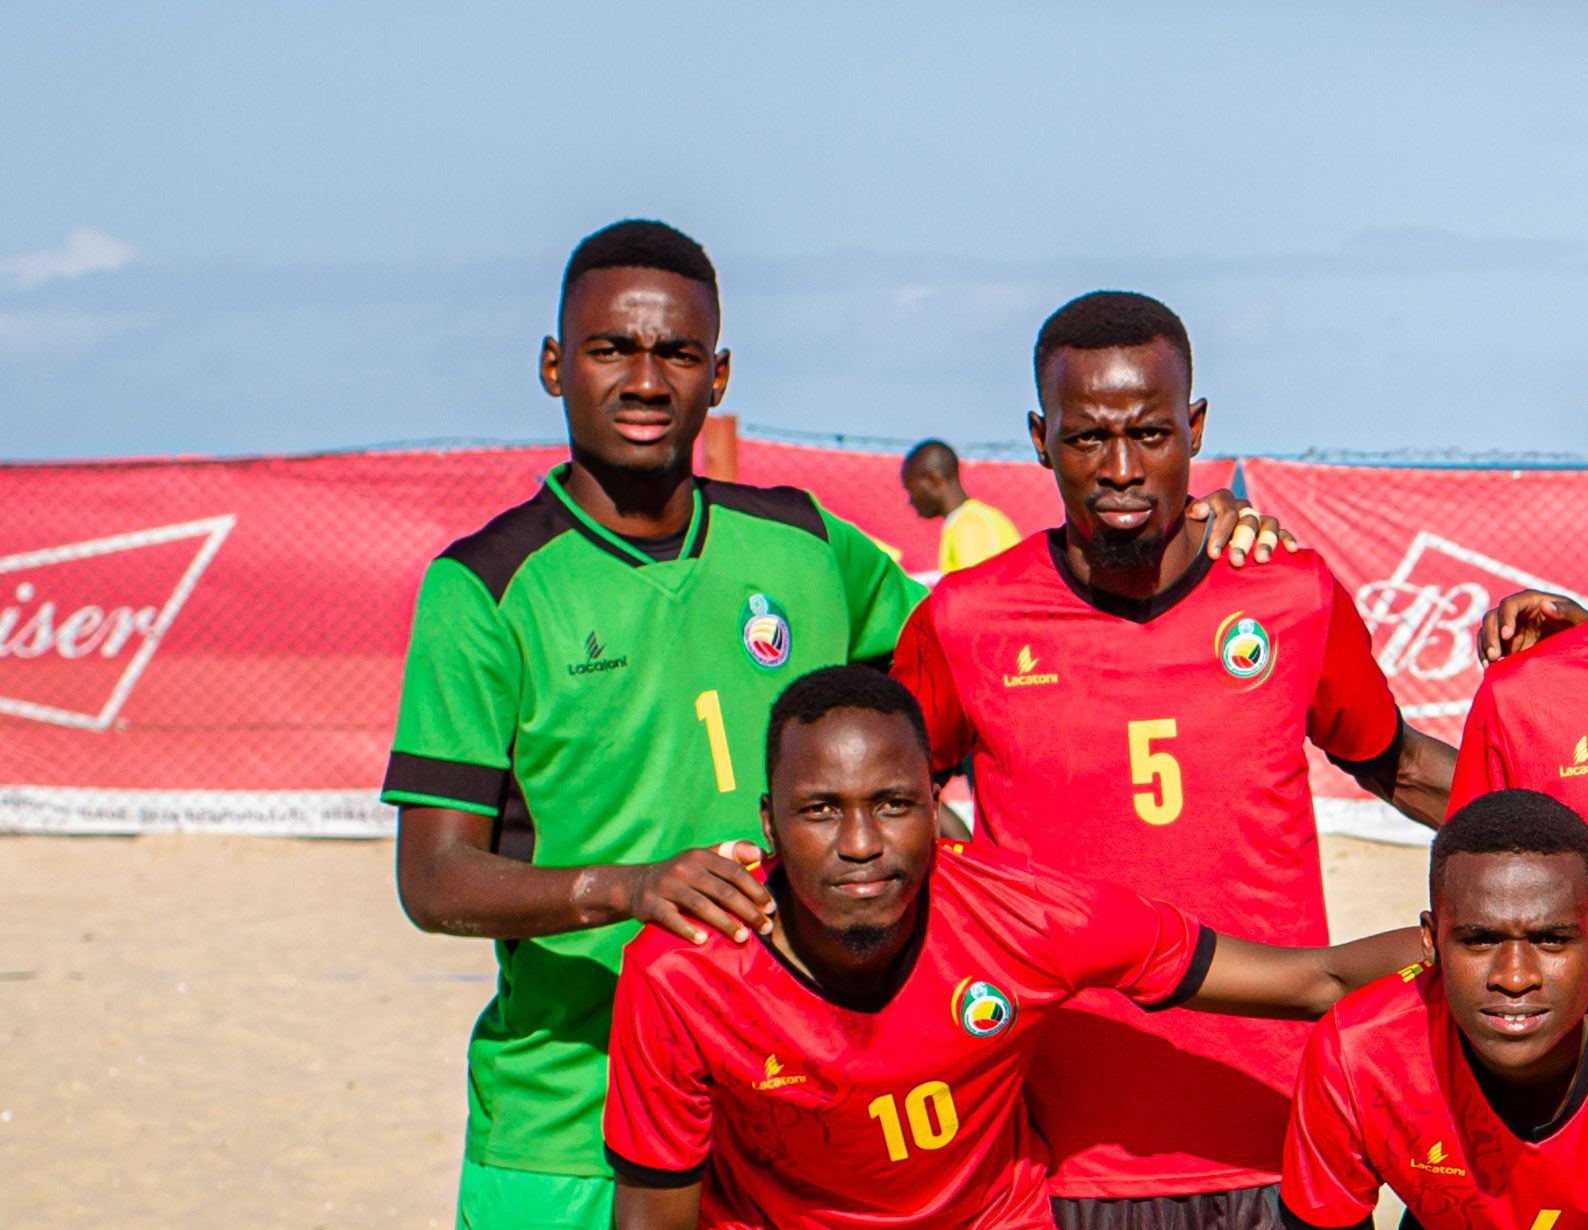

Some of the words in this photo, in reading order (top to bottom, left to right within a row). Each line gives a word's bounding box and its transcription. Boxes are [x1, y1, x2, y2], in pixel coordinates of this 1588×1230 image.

[1003, 673, 1059, 687] Lacatoni
[695, 689, 736, 793] 1
[1128, 718, 1183, 826] 5
[751, 1074, 806, 1091] Lacatoni
[868, 1080, 960, 1163] 10
[1410, 1158, 1466, 1177] Lacatoni
